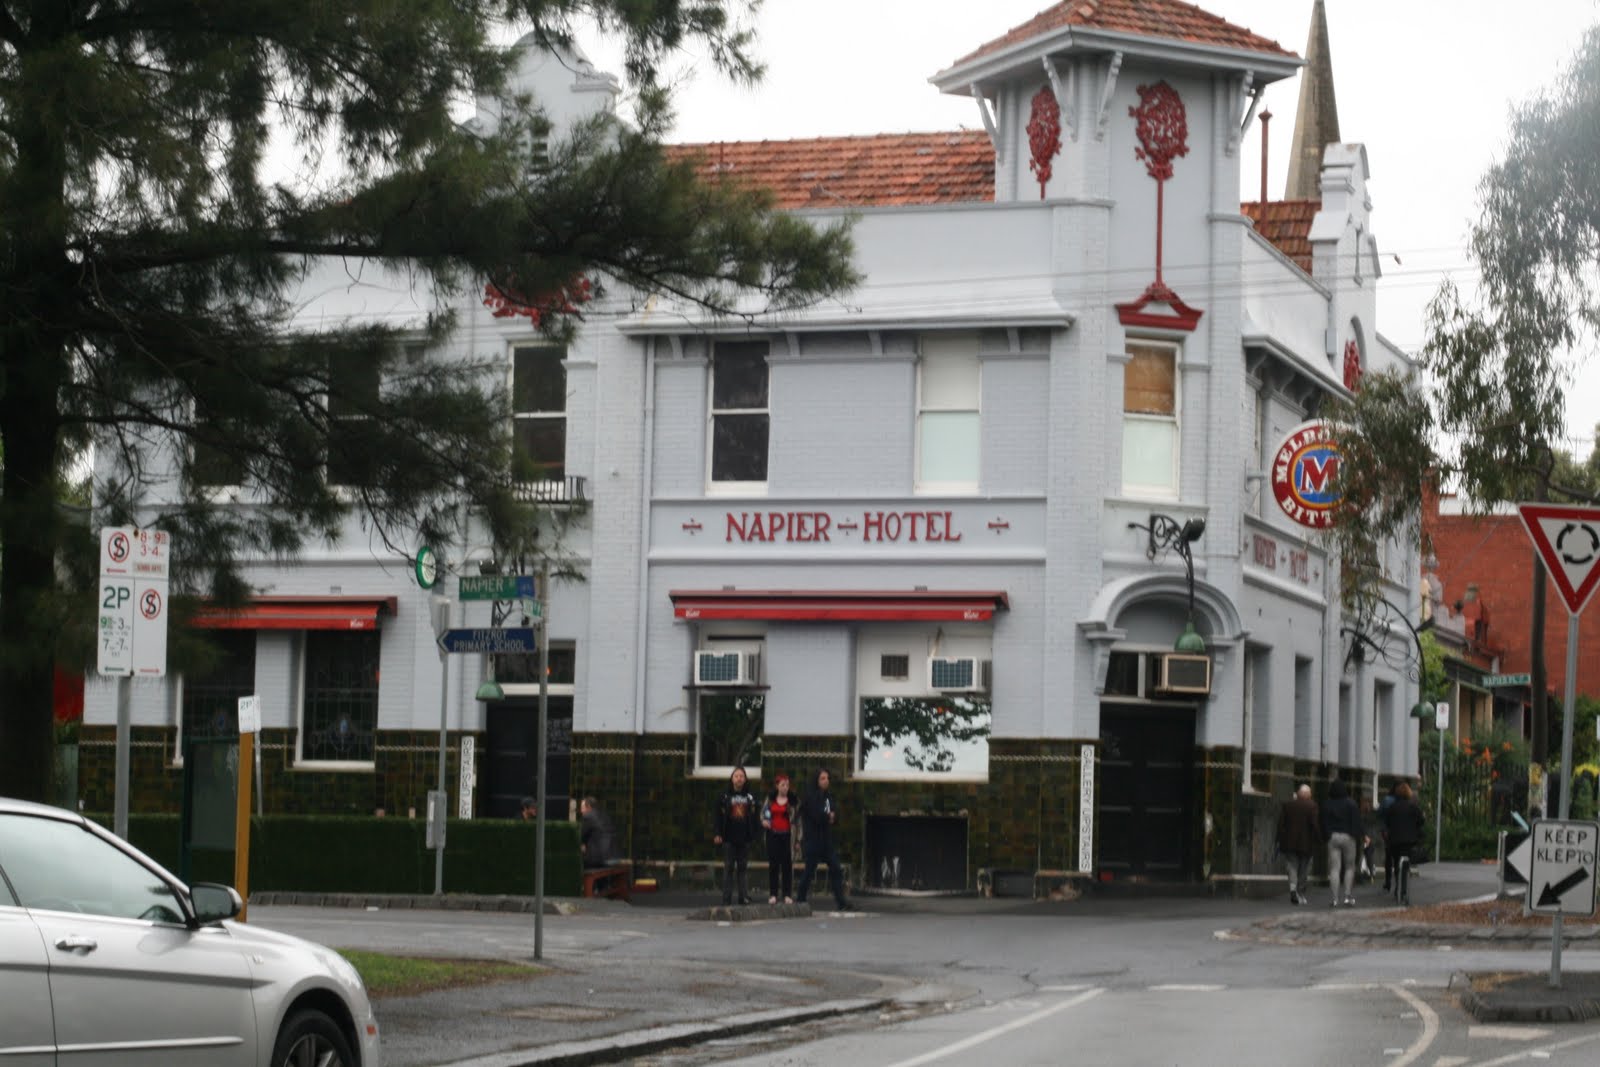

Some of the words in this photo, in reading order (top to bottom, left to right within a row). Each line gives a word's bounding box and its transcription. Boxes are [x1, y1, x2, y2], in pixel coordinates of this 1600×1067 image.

[726, 512, 832, 542] NAPIER
[863, 511, 962, 542] HOTEL
[462, 578, 504, 593] NAPIER
[103, 586, 130, 609] 2P
[472, 630, 508, 641] FITZROY
[453, 640, 490, 653] PRIMARY
[494, 640, 525, 652] SCHOOL
[1082, 747, 1093, 804] GALLERY
[1080, 807, 1092, 870] UPSTAIRS
[1544, 828, 1588, 845] KEEP
[1537, 847, 1594, 865] KLEPTO
